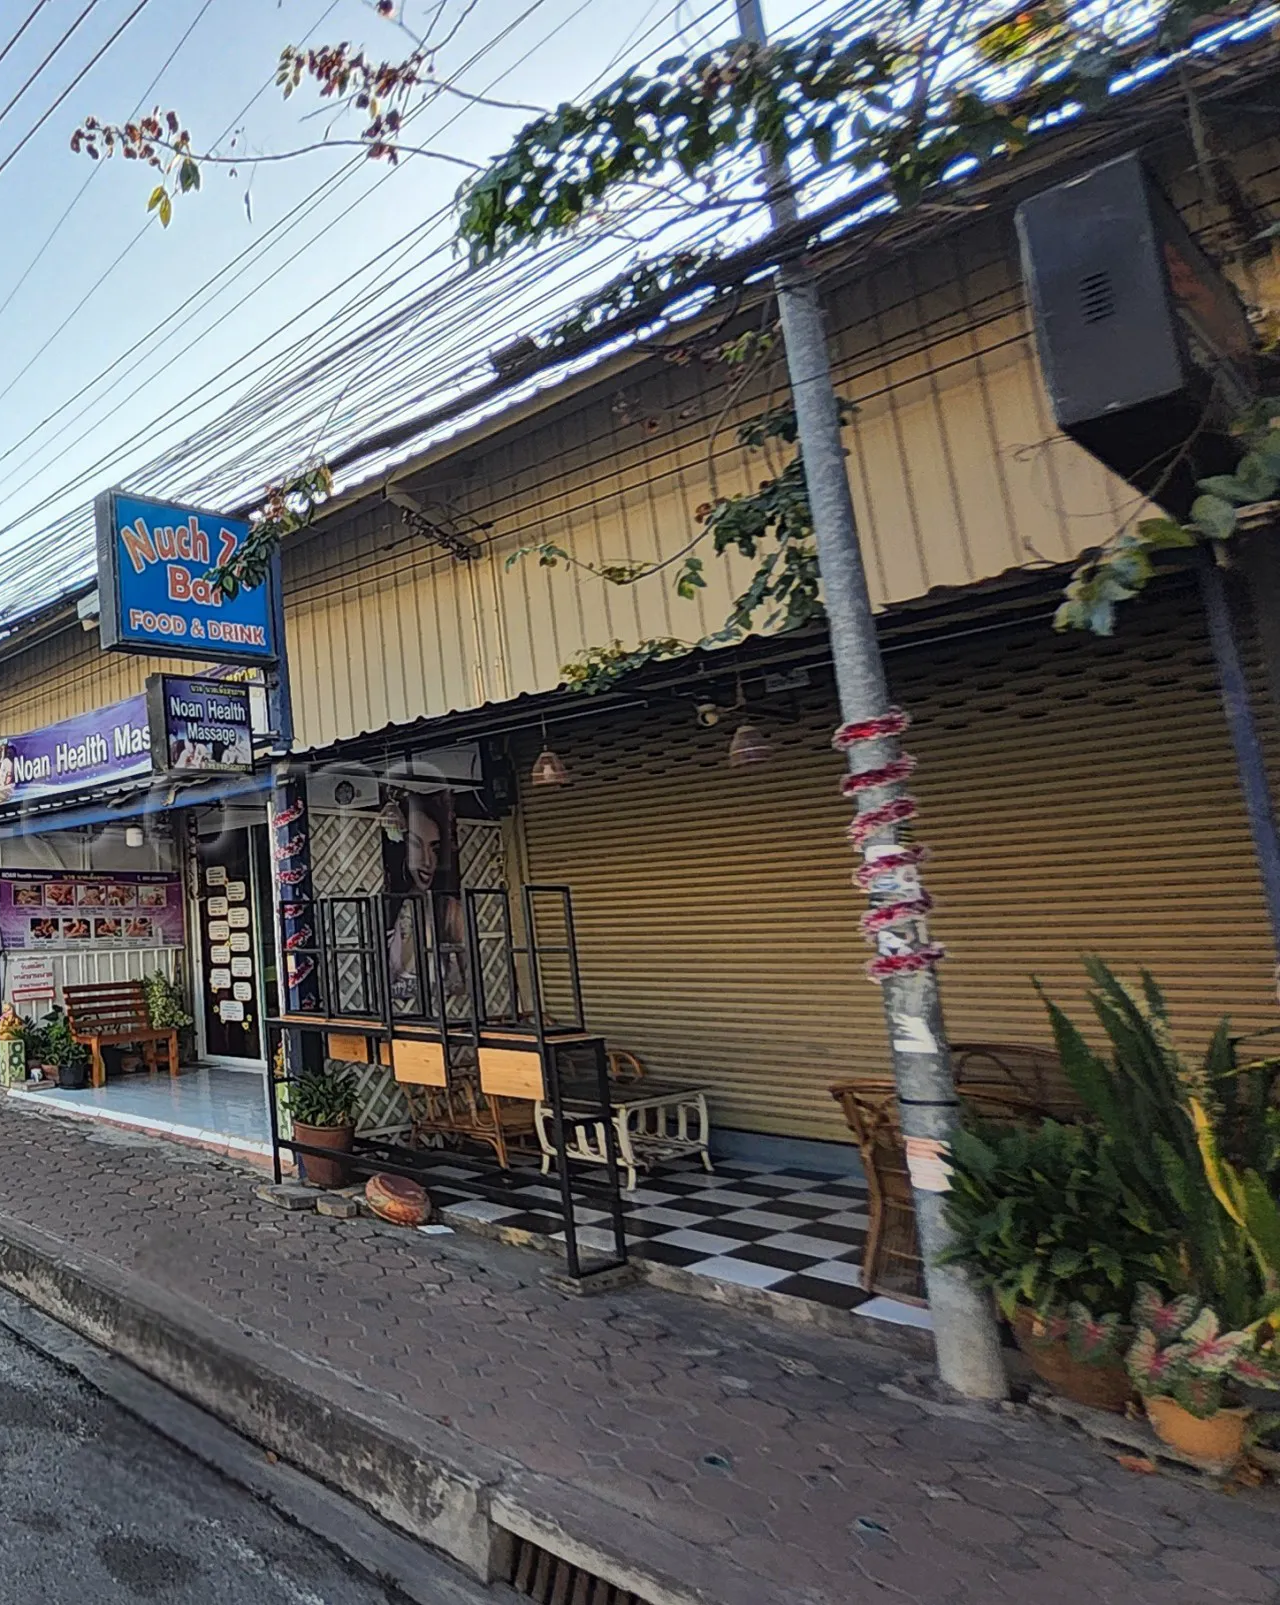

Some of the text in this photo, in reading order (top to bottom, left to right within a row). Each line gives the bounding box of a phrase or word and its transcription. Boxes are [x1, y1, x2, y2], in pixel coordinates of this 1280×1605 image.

[121, 516, 210, 574] Nuch
[129, 609, 266, 646] FOOD & DRINK
[170, 697, 246, 721] Noan Health
[187, 722, 236, 745] Massage
[14, 723, 152, 783] Noan Health Mas
